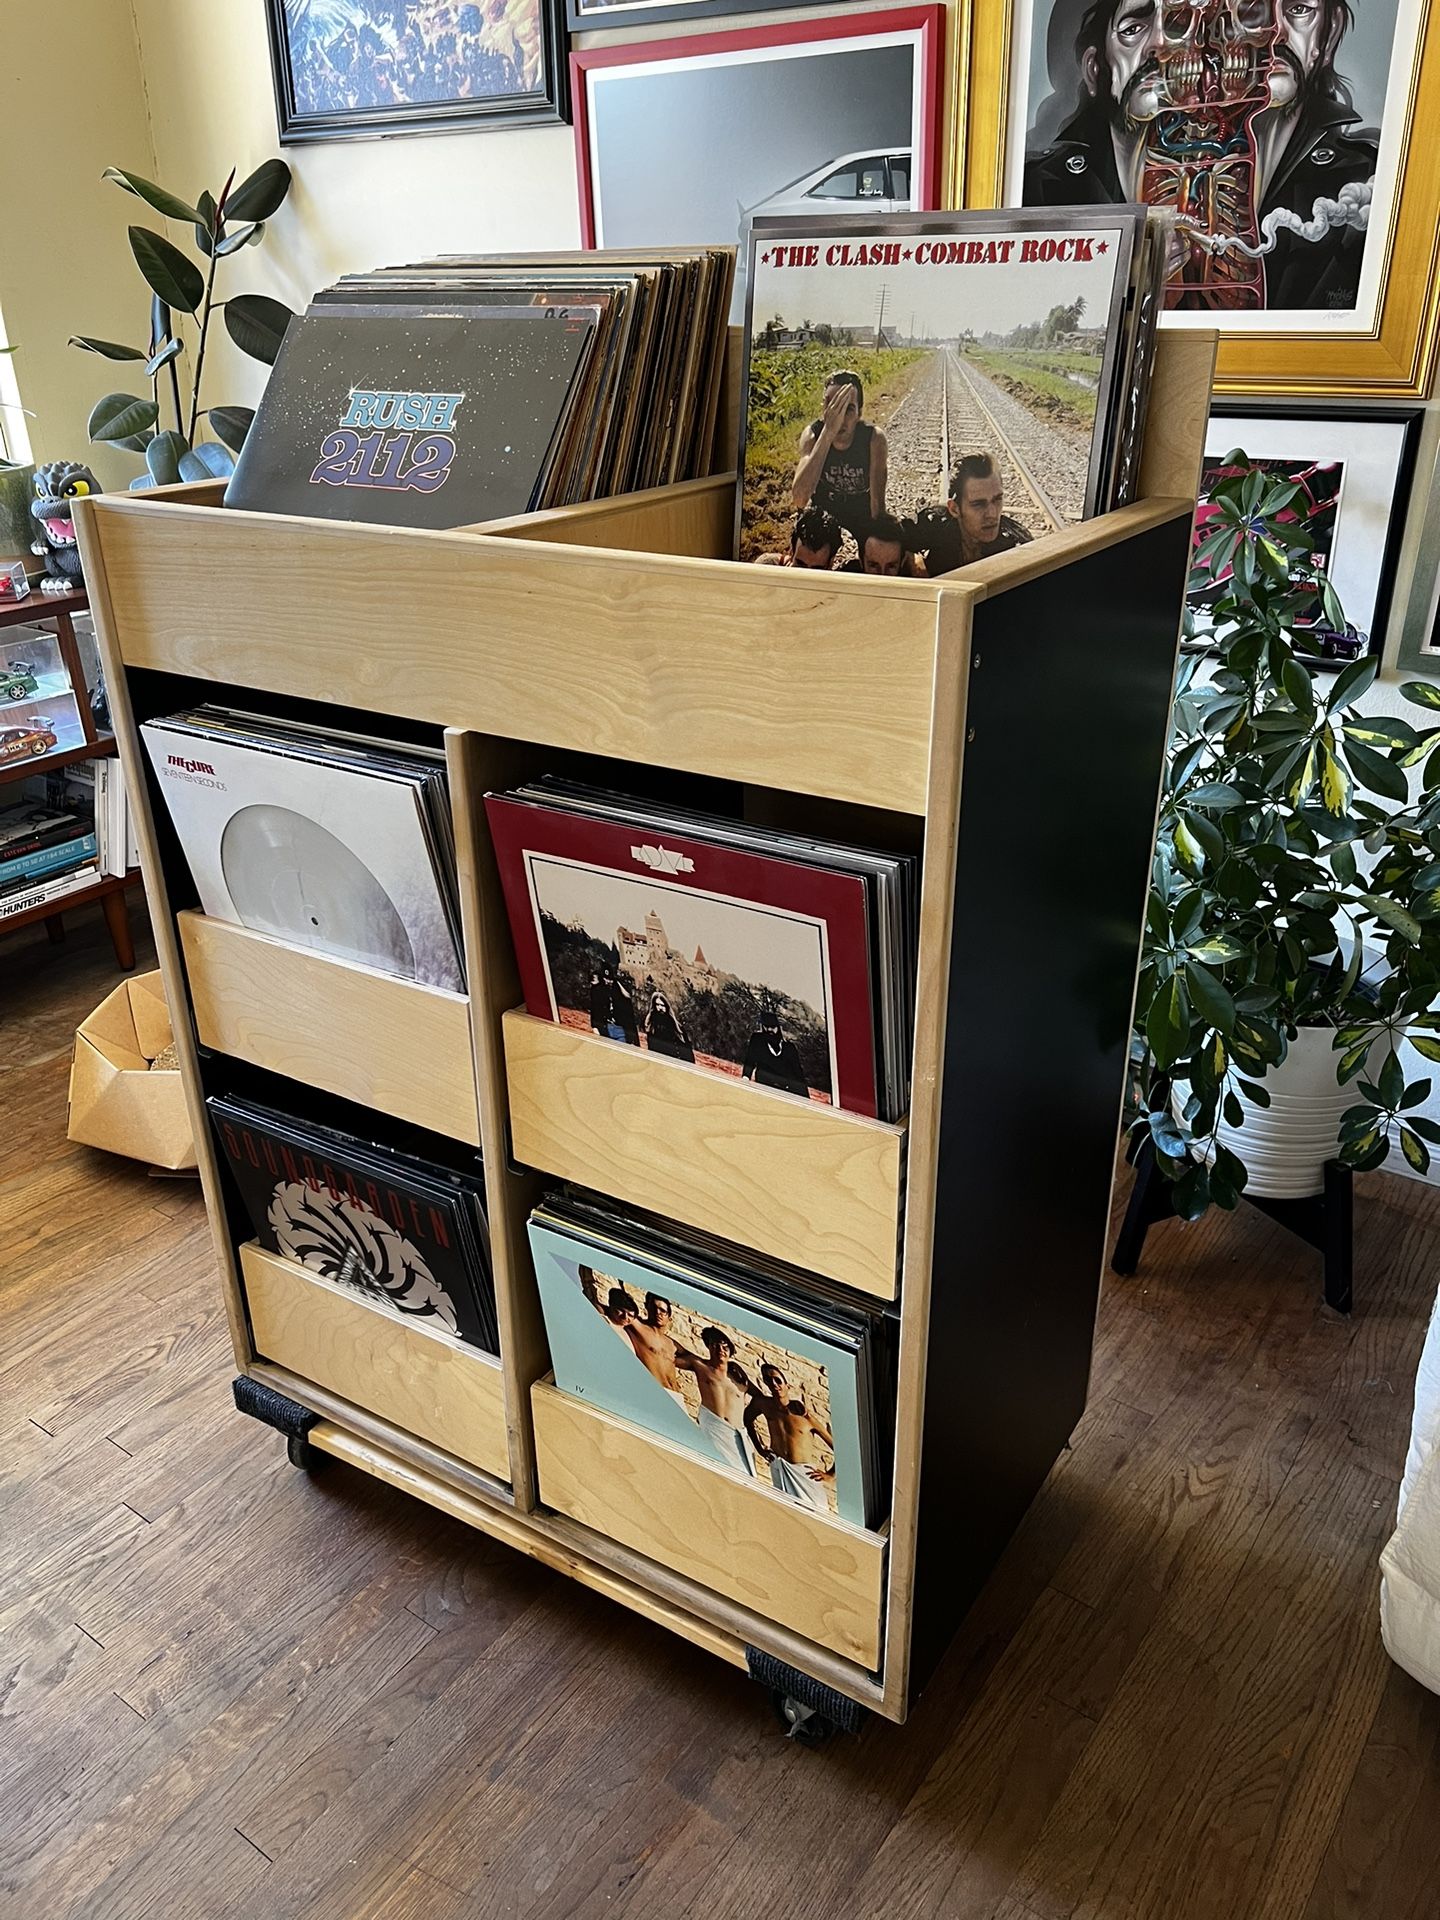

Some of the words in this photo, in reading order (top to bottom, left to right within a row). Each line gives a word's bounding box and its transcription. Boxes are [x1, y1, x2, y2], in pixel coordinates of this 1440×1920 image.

[771, 245, 820, 268] THE
[825, 243, 903, 267] CLASH
[914, 240, 1015, 265] COMBAT
[1019, 238, 1096, 263] ROCK
[339, 390, 465, 432] RUSH
[309, 428, 457, 494] 2112
[167, 754, 186, 767] THE
[184, 760, 217, 776] CURE
[3, 893, 46, 916] HUNTERS
[223, 1121, 450, 1249] SOUNDGARDEN
